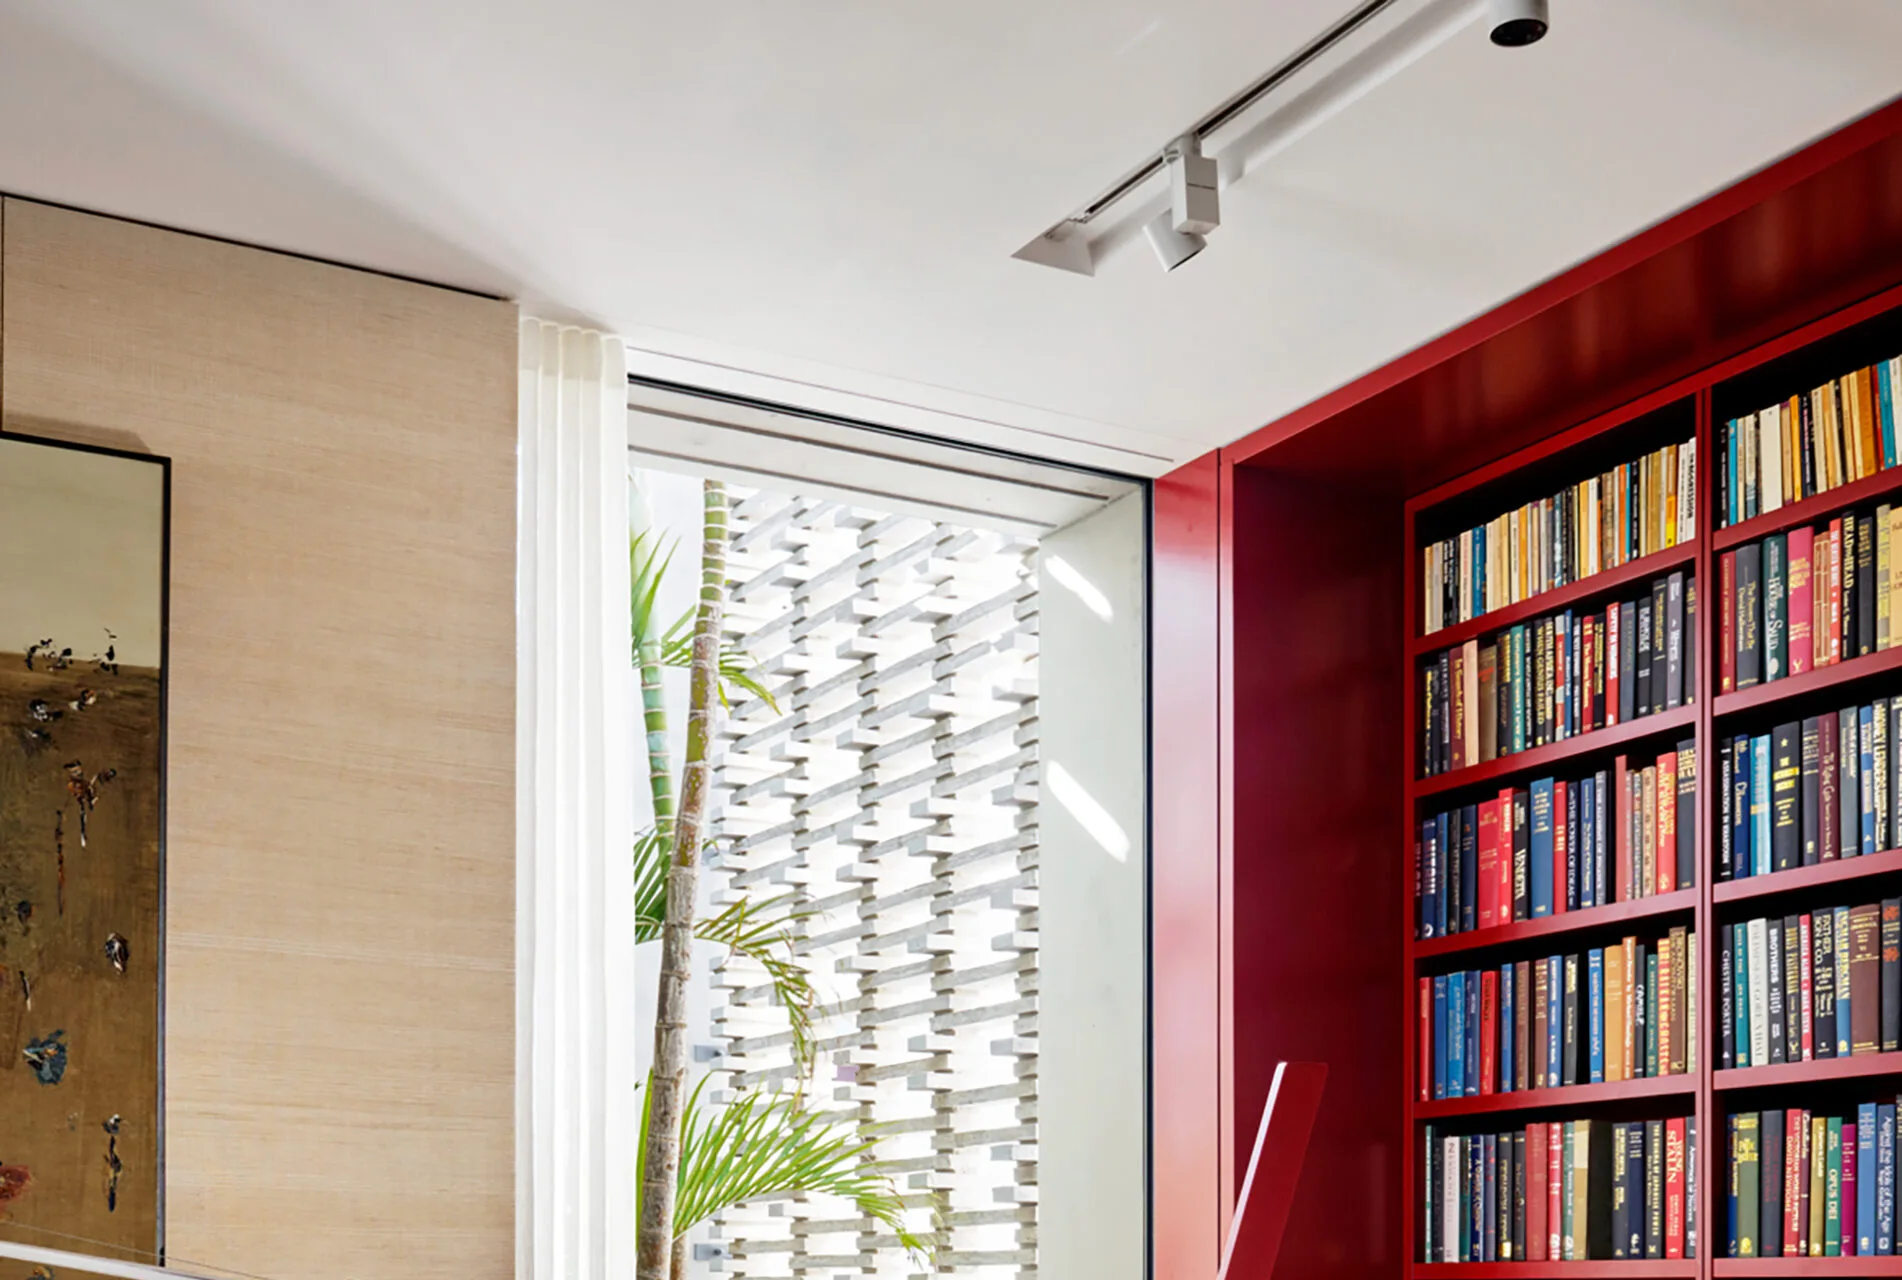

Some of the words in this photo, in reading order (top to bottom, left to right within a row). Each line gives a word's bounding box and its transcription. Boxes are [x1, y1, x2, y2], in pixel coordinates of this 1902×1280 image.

[1843, 515, 1854, 549] HEAD
[1843, 556, 1854, 589] HEAD
[1768, 619, 1784, 651] SAUD
[1769, 928, 1778, 983] BROTHERS
[1722, 950, 1731, 994] CHESTER
[1753, 989, 1763, 1018] GORE
[1754, 1022, 1764, 1058] VIDAL
[1882, 1116, 1893, 1147] Against
[1667, 1129, 1677, 1183] STALIN
[1785, 1135, 1793, 1165] DAVID
[1884, 1150, 1893, 1163] the
[1653, 1166, 1660, 1174] OF
[1828, 1168, 1838, 1198] OPUS
[1883, 1198, 1892, 1212] the
[1884, 1187, 1893, 1197] of
[1652, 1210, 1660, 1236] POWER
[1828, 1200, 1838, 1220] DEI
[1881, 1216, 1891, 1233] Age
